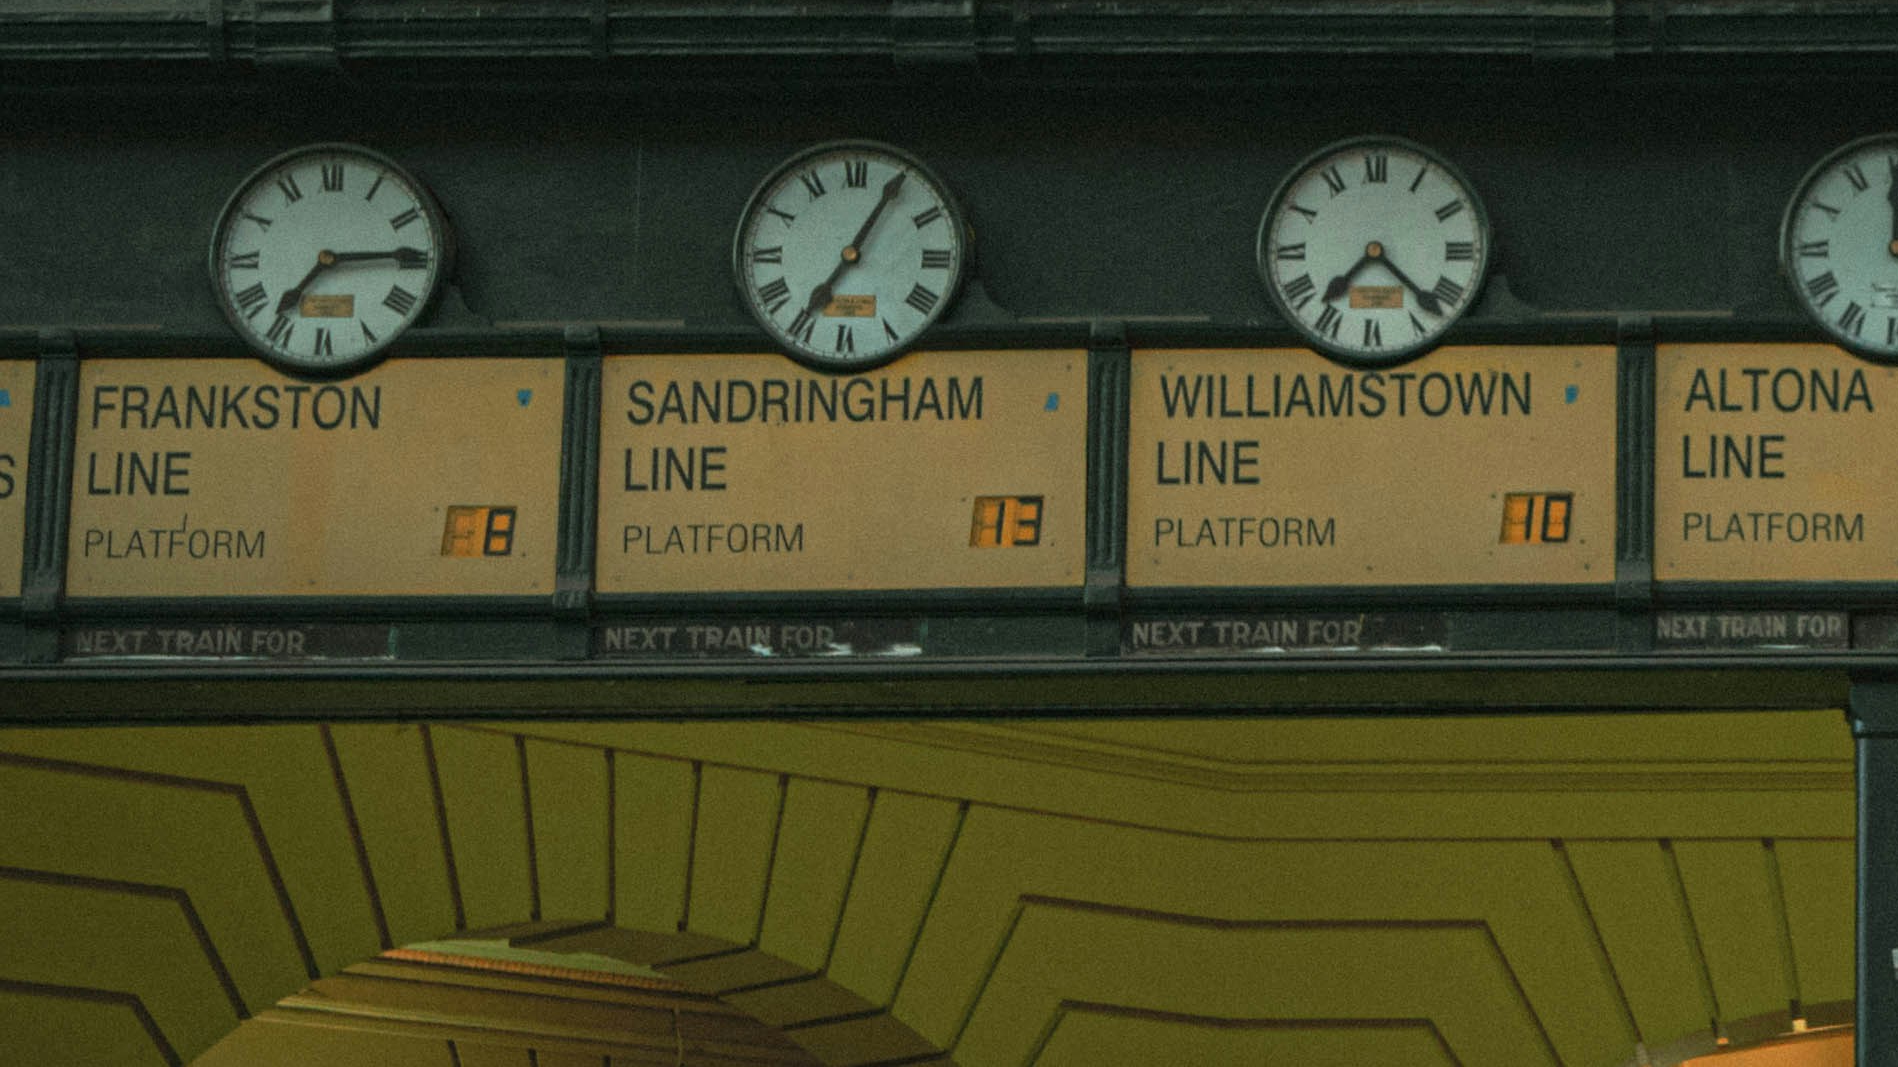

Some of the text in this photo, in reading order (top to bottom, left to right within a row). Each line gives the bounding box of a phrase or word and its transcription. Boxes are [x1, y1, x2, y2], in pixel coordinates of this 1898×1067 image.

[92, 385, 381, 430] FRANKSTON
[627, 376, 983, 425] SANDRINGHAM
[1160, 372, 1531, 418] WILLIAMSTOWN
[1685, 368, 1874, 413] ALTONA
[88, 451, 191, 495] LINE
[624, 446, 727, 491] LINE
[1157, 440, 1260, 485] LINE
[1683, 435, 1786, 479] LINE
[485, 508, 516, 557] 8
[623, 523, 804, 554] PLATFORM
[996, 495, 1043, 545] 13
[1155, 517, 1335, 548] PLATFORM
[1525, 495, 1573, 543] 10
[1683, 512, 1864, 542] PLATFORM
[84, 529, 265, 559] PLATFORM
[77, 629, 305, 653] NEXT TRAIN FOR
[605, 626, 834, 649] NEXT TRAIN FOR
[1132, 621, 1360, 646] NEXT TRAIN FOR
[1657, 615, 1841, 639] NEXT TRAIN FOR
